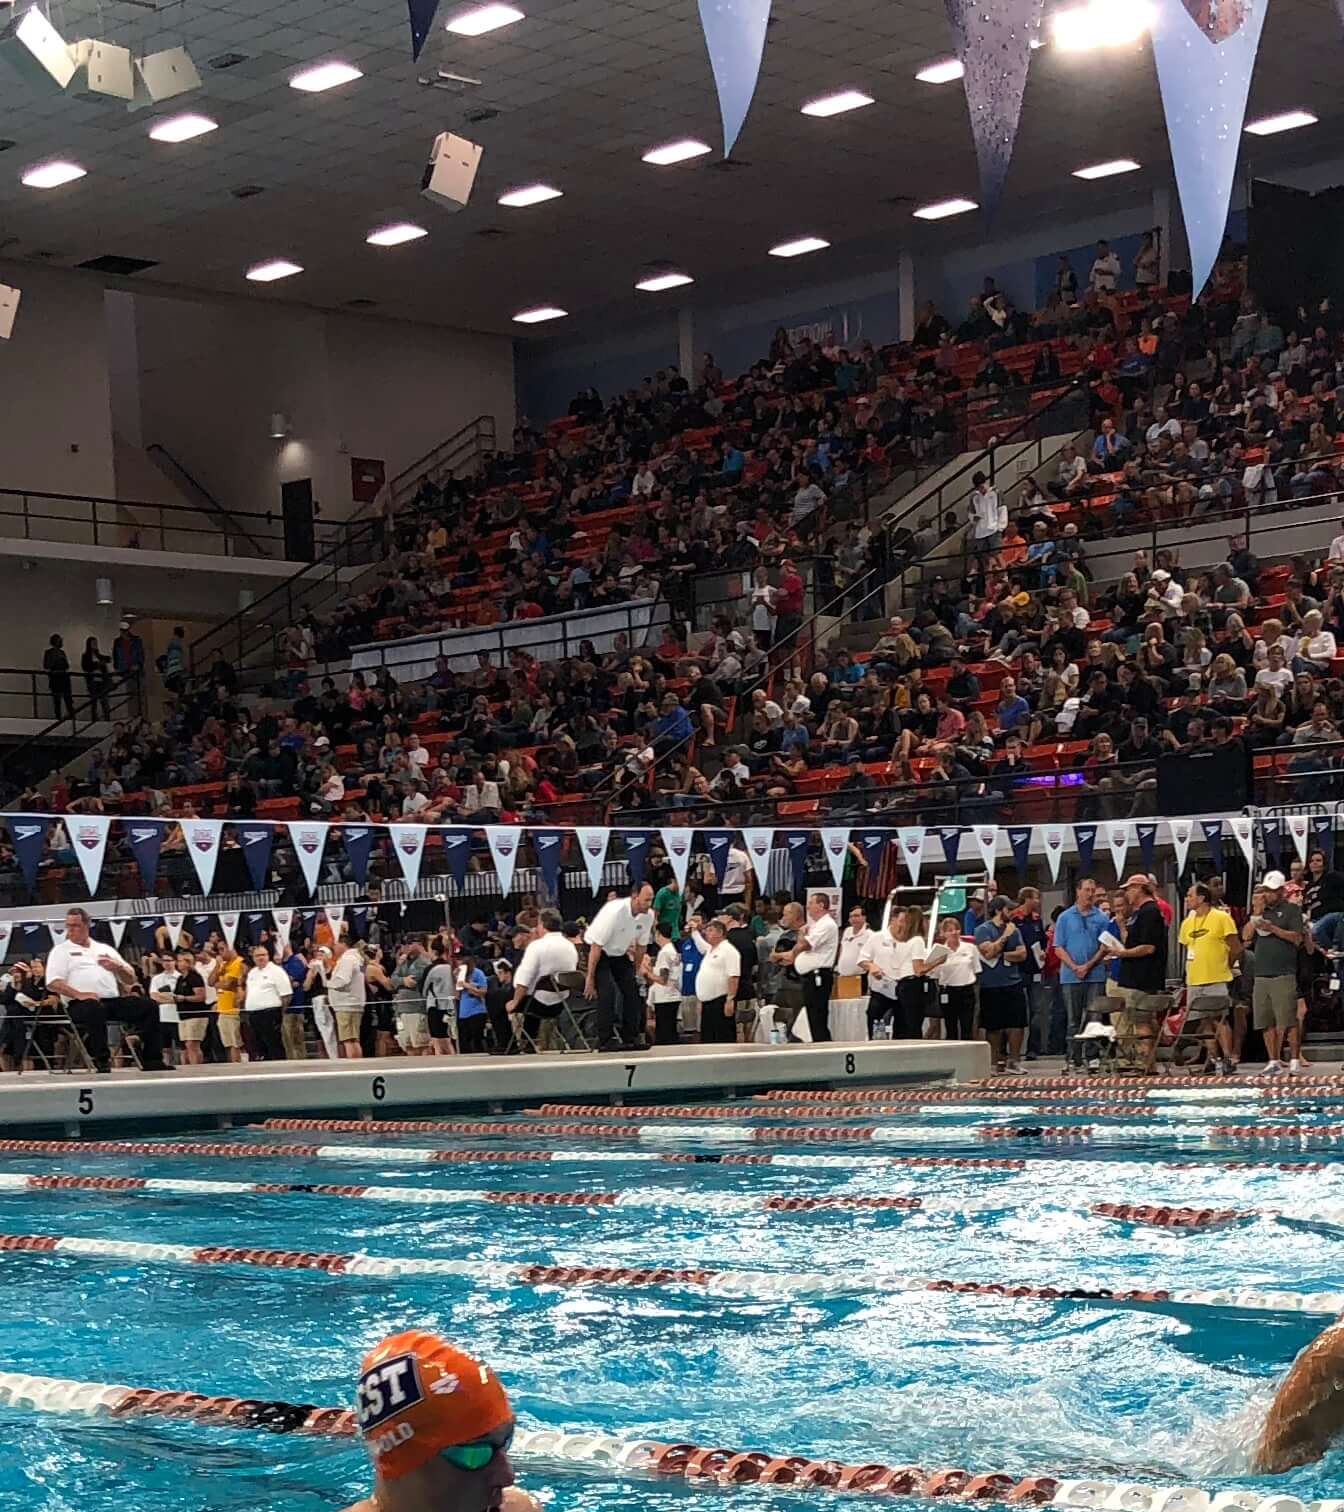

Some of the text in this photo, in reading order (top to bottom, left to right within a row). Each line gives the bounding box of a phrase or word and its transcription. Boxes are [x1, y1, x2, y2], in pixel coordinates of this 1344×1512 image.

[846, 1053, 855, 1074] 8
[624, 1065, 637, 1087] 7
[372, 1076, 386, 1100] 6
[79, 1089, 93, 1115] 5
